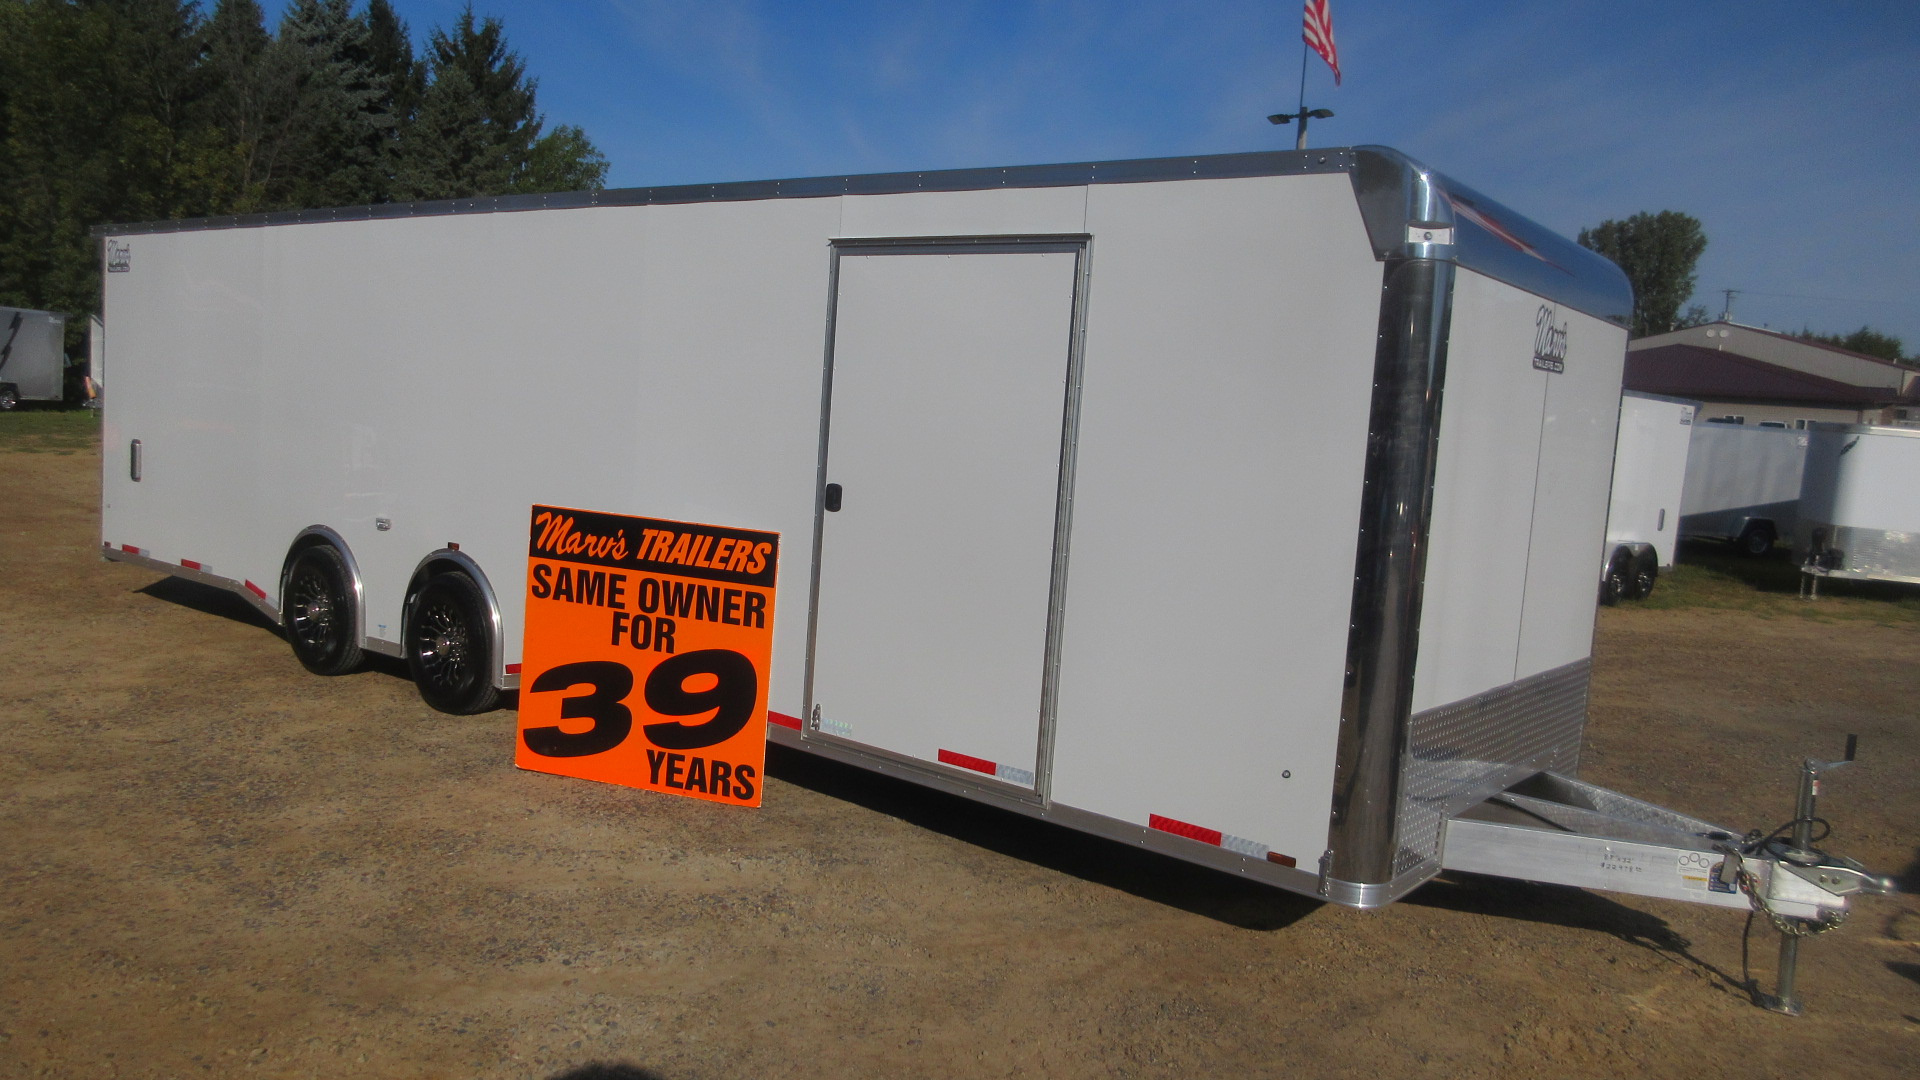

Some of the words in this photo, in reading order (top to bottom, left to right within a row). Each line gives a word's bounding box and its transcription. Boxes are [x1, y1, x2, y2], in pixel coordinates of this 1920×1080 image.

[535, 512, 629, 560] Marv's
[636, 528, 772, 575] TRAILERS
[531, 563, 627, 609] SAME
[637, 577, 766, 629] OWNER
[611, 611, 676, 654] FOR
[522, 648, 758, 758] 39
[646, 748, 756, 800] YEARS
